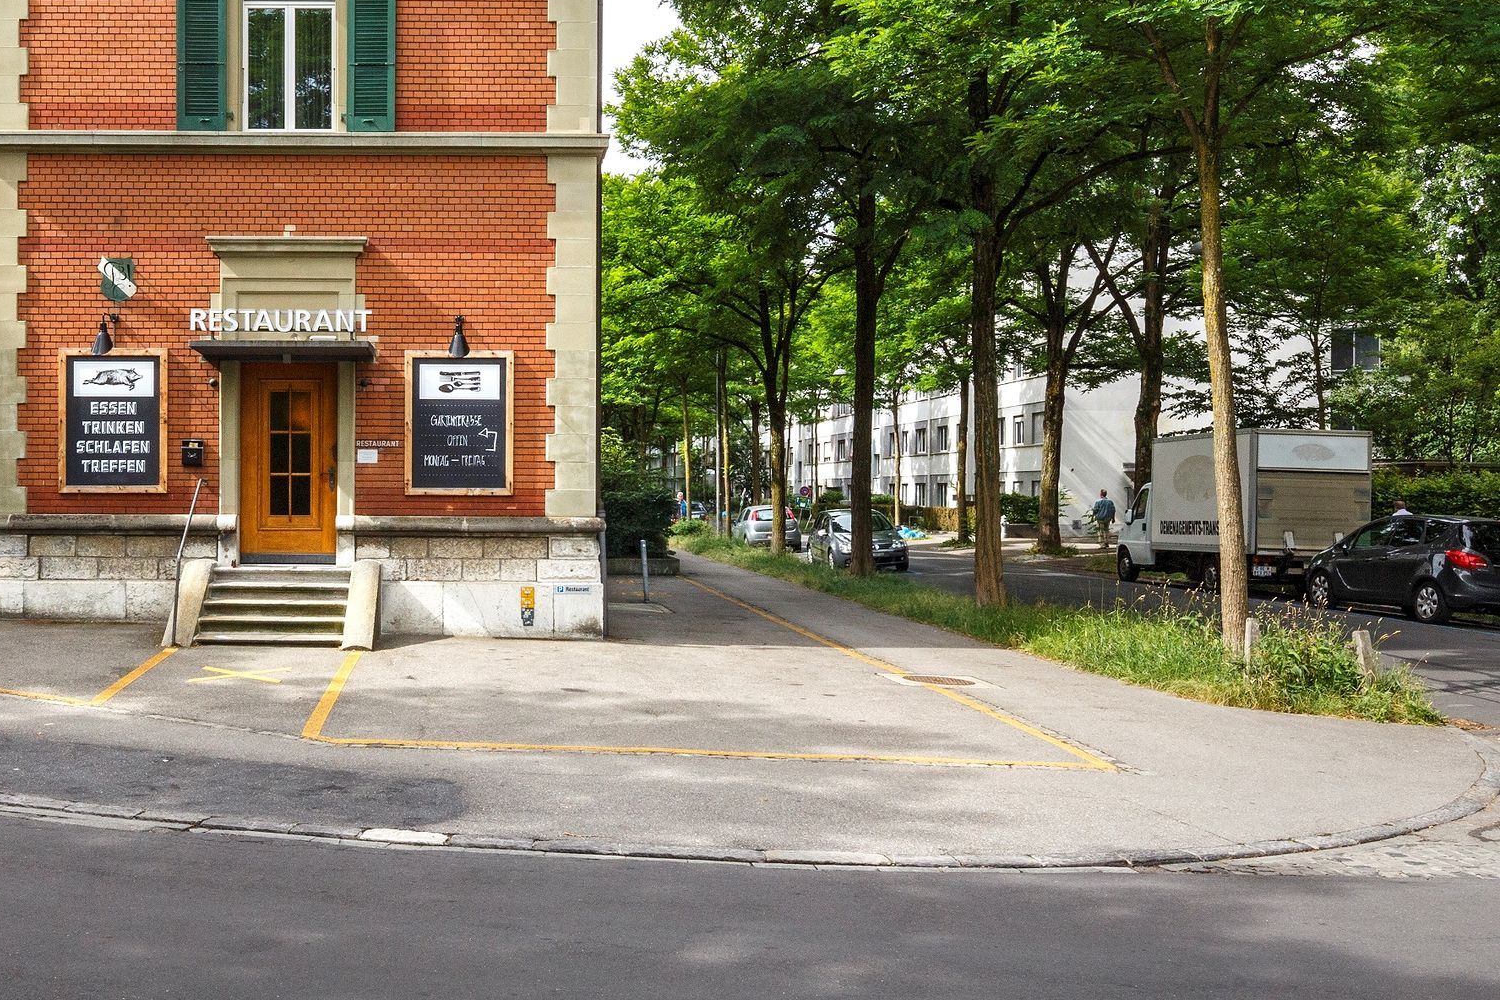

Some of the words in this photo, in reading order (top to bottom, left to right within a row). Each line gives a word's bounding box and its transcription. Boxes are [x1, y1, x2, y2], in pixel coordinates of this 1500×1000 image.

[189, 308, 373, 333] RESTAURANT
[90, 401, 138, 416] ESSEN
[81, 420, 146, 435] TRINKEN
[76, 440, 151, 454] SCHLAFEN
[81, 459, 146, 473] TREFFEN
